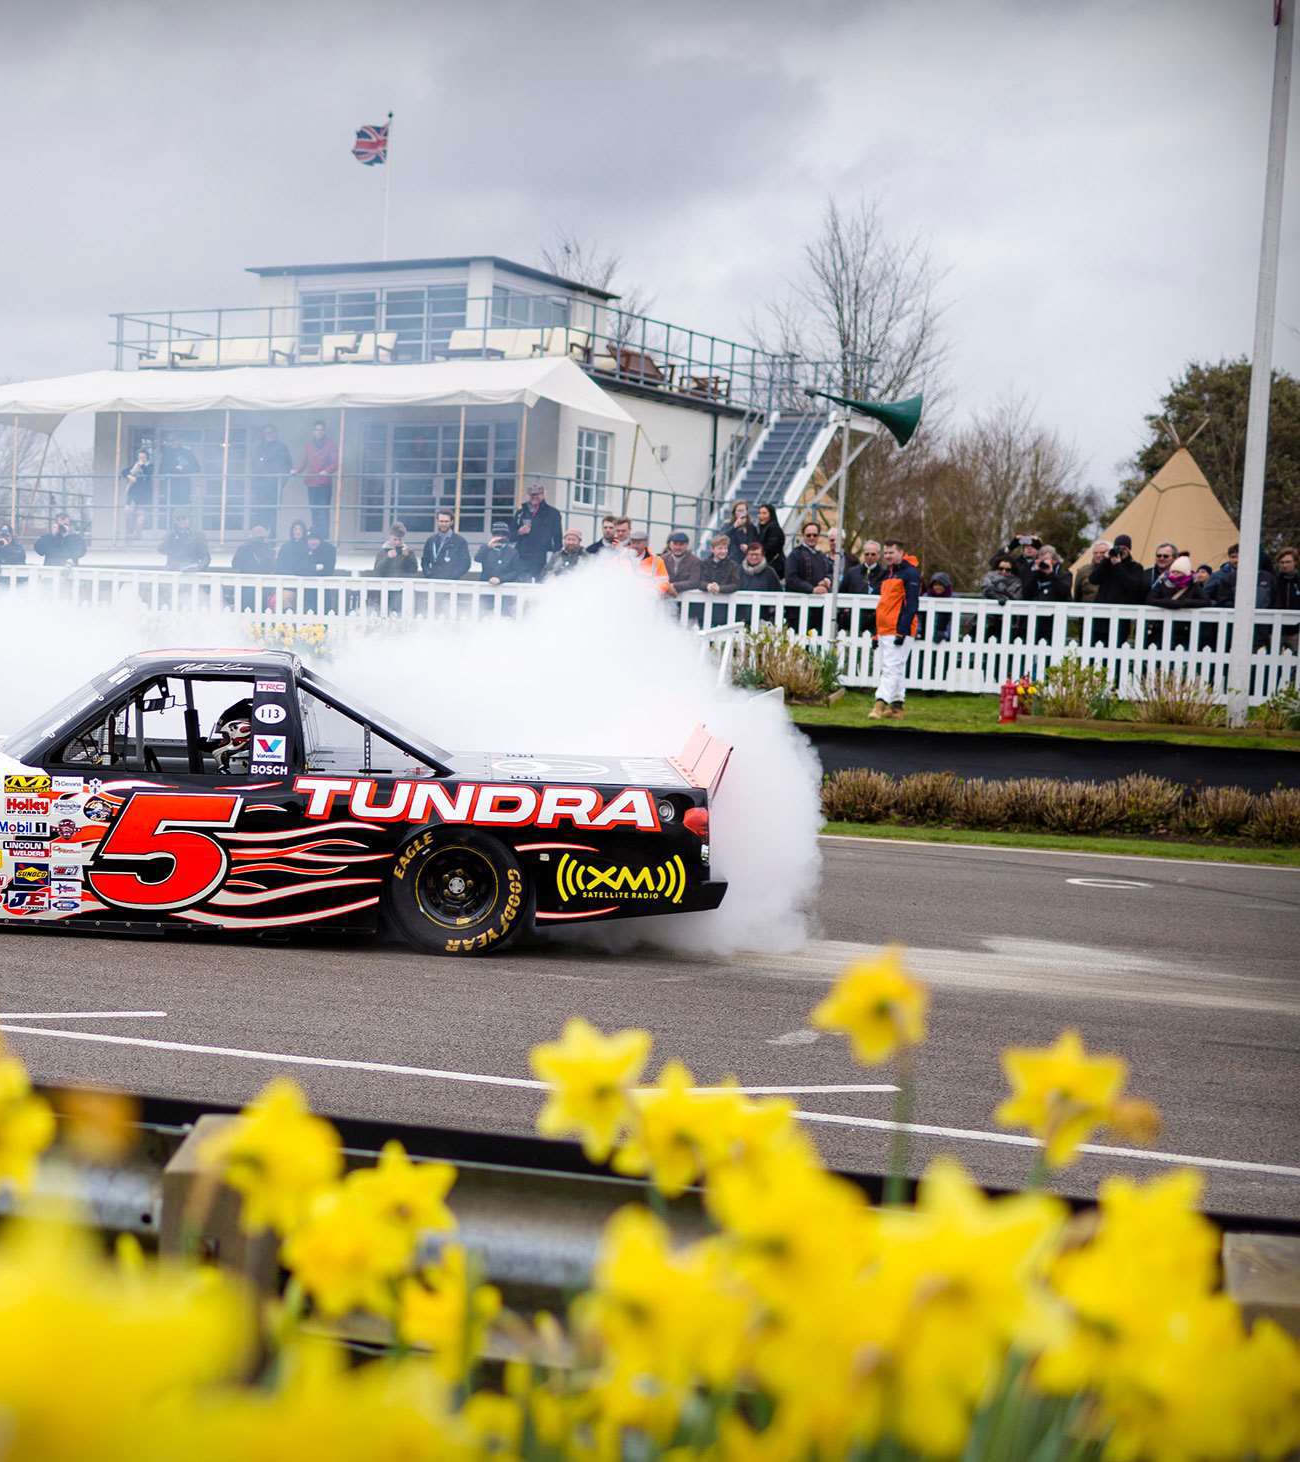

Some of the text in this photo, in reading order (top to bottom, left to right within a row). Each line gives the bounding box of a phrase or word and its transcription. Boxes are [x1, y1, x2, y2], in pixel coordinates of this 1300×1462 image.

[261, 709, 280, 719] 113
[251, 765, 288, 775] BOSCH
[7, 798, 49, 814] Holley
[292, 776, 662, 831] TUNDRA
[4, 842, 42, 850] LINCOLN
[88, 792, 244, 910] 5
[393, 831, 434, 880] EAGLE
[587, 866, 655, 891] XM
[9, 892, 46, 907] JE
